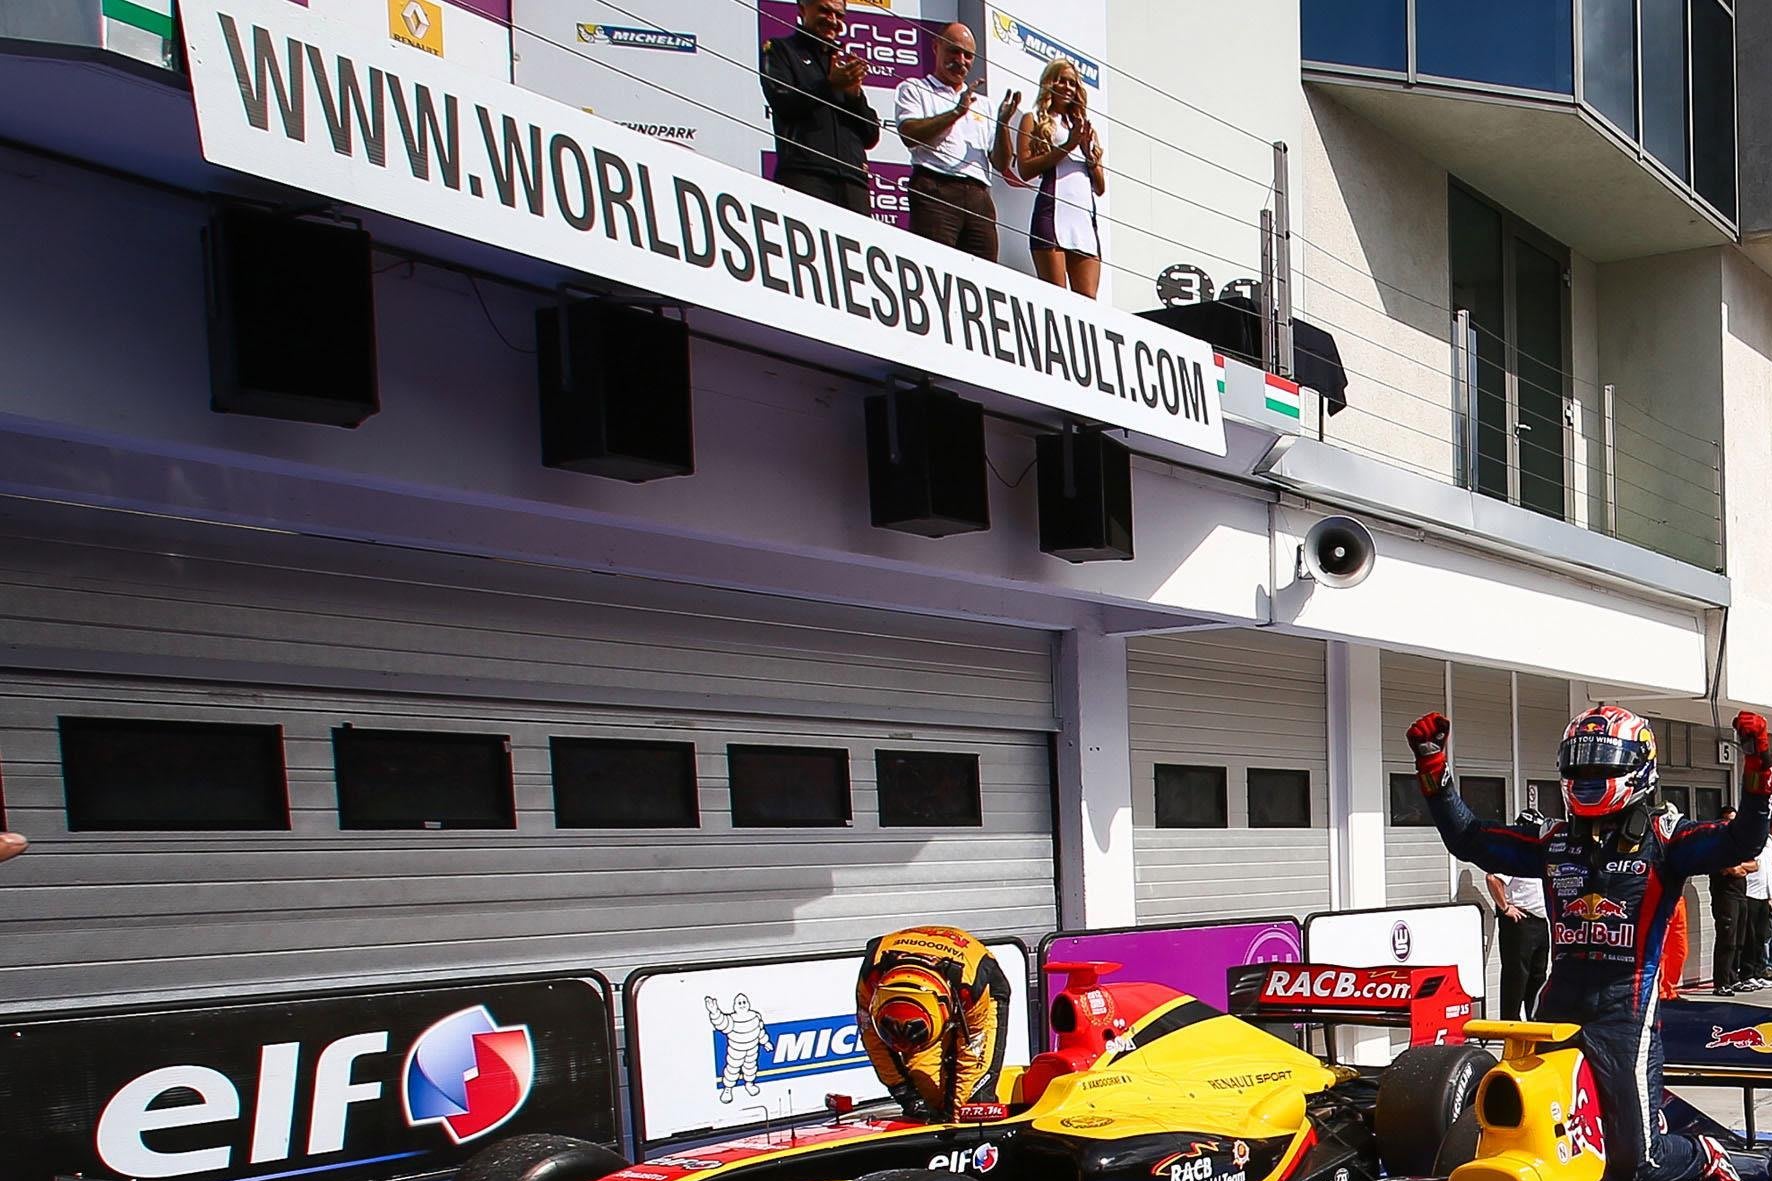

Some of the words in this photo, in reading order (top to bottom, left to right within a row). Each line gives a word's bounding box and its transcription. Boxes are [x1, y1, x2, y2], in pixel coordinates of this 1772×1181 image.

[612, 30, 695, 48] MICHELIN
[218, 11, 1211, 427] WWW.WORLDSERIESBYRENAULT.COM
[1606, 860, 1632, 873] elf
[1555, 921, 1589, 945] Red
[1591, 922, 1635, 948] Bull
[1265, 970, 1411, 999] RACB.com
[1209, 1074, 1254, 1091] RENAULT
[1255, 1070, 1293, 1085] SPORT
[96, 1030, 389, 1180] elf
[928, 1148, 973, 1173] elf
